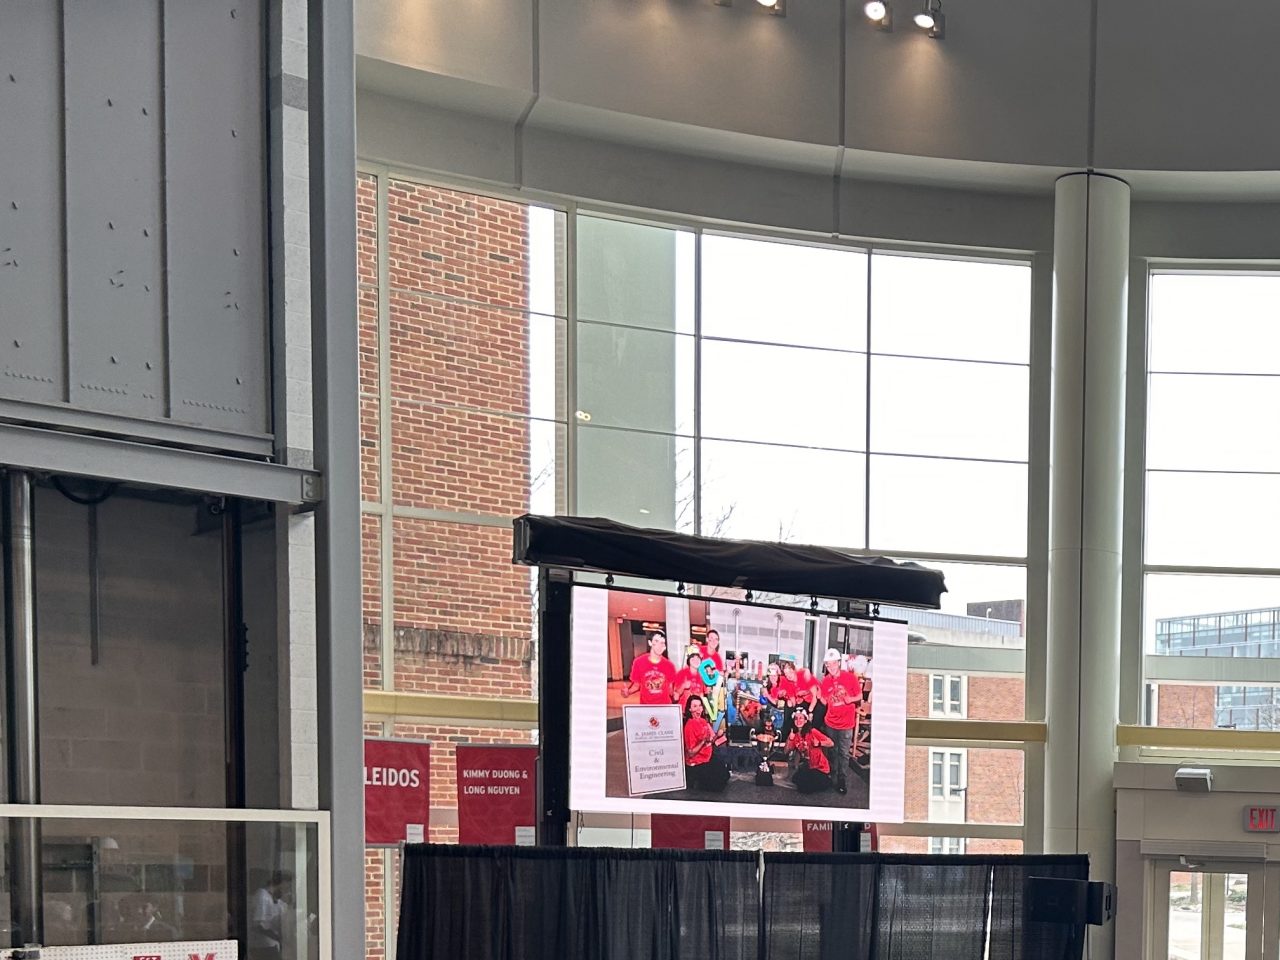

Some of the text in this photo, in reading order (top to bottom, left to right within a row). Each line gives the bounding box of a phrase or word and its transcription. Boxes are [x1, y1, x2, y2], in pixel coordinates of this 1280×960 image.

[648, 749, 664, 757] Civil
[634, 762, 679, 773] Environmental
[364, 767, 420, 788] LEIDOS
[463, 769, 528, 779] KIMMY DUONG &
[639, 771, 676, 780] Engineering
[463, 786, 520, 795] LONG NGUYEN
[1249, 807, 1277, 831] EXIT
